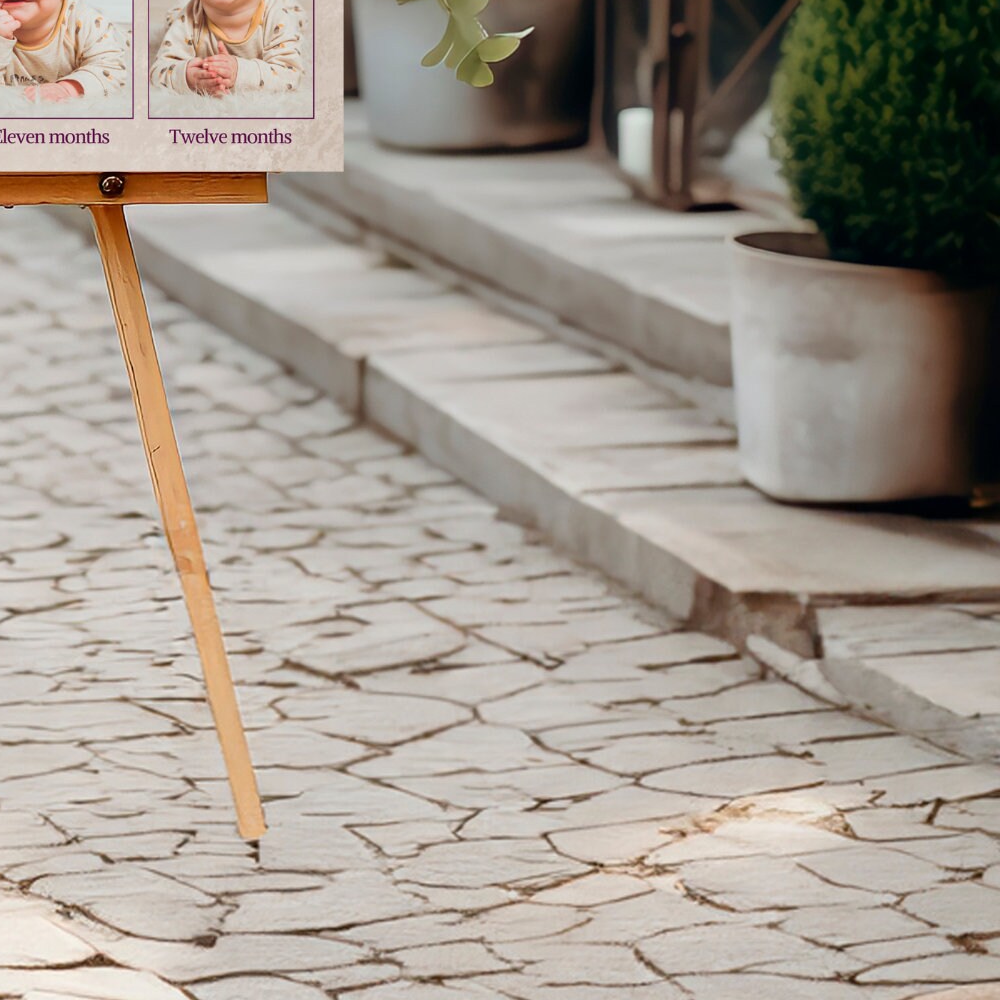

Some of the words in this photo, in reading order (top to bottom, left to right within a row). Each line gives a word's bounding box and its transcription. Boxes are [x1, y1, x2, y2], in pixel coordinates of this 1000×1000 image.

[48, 128, 110, 145] months
[168, 128, 228, 145] Twelve
[230, 128, 293, 145] months
